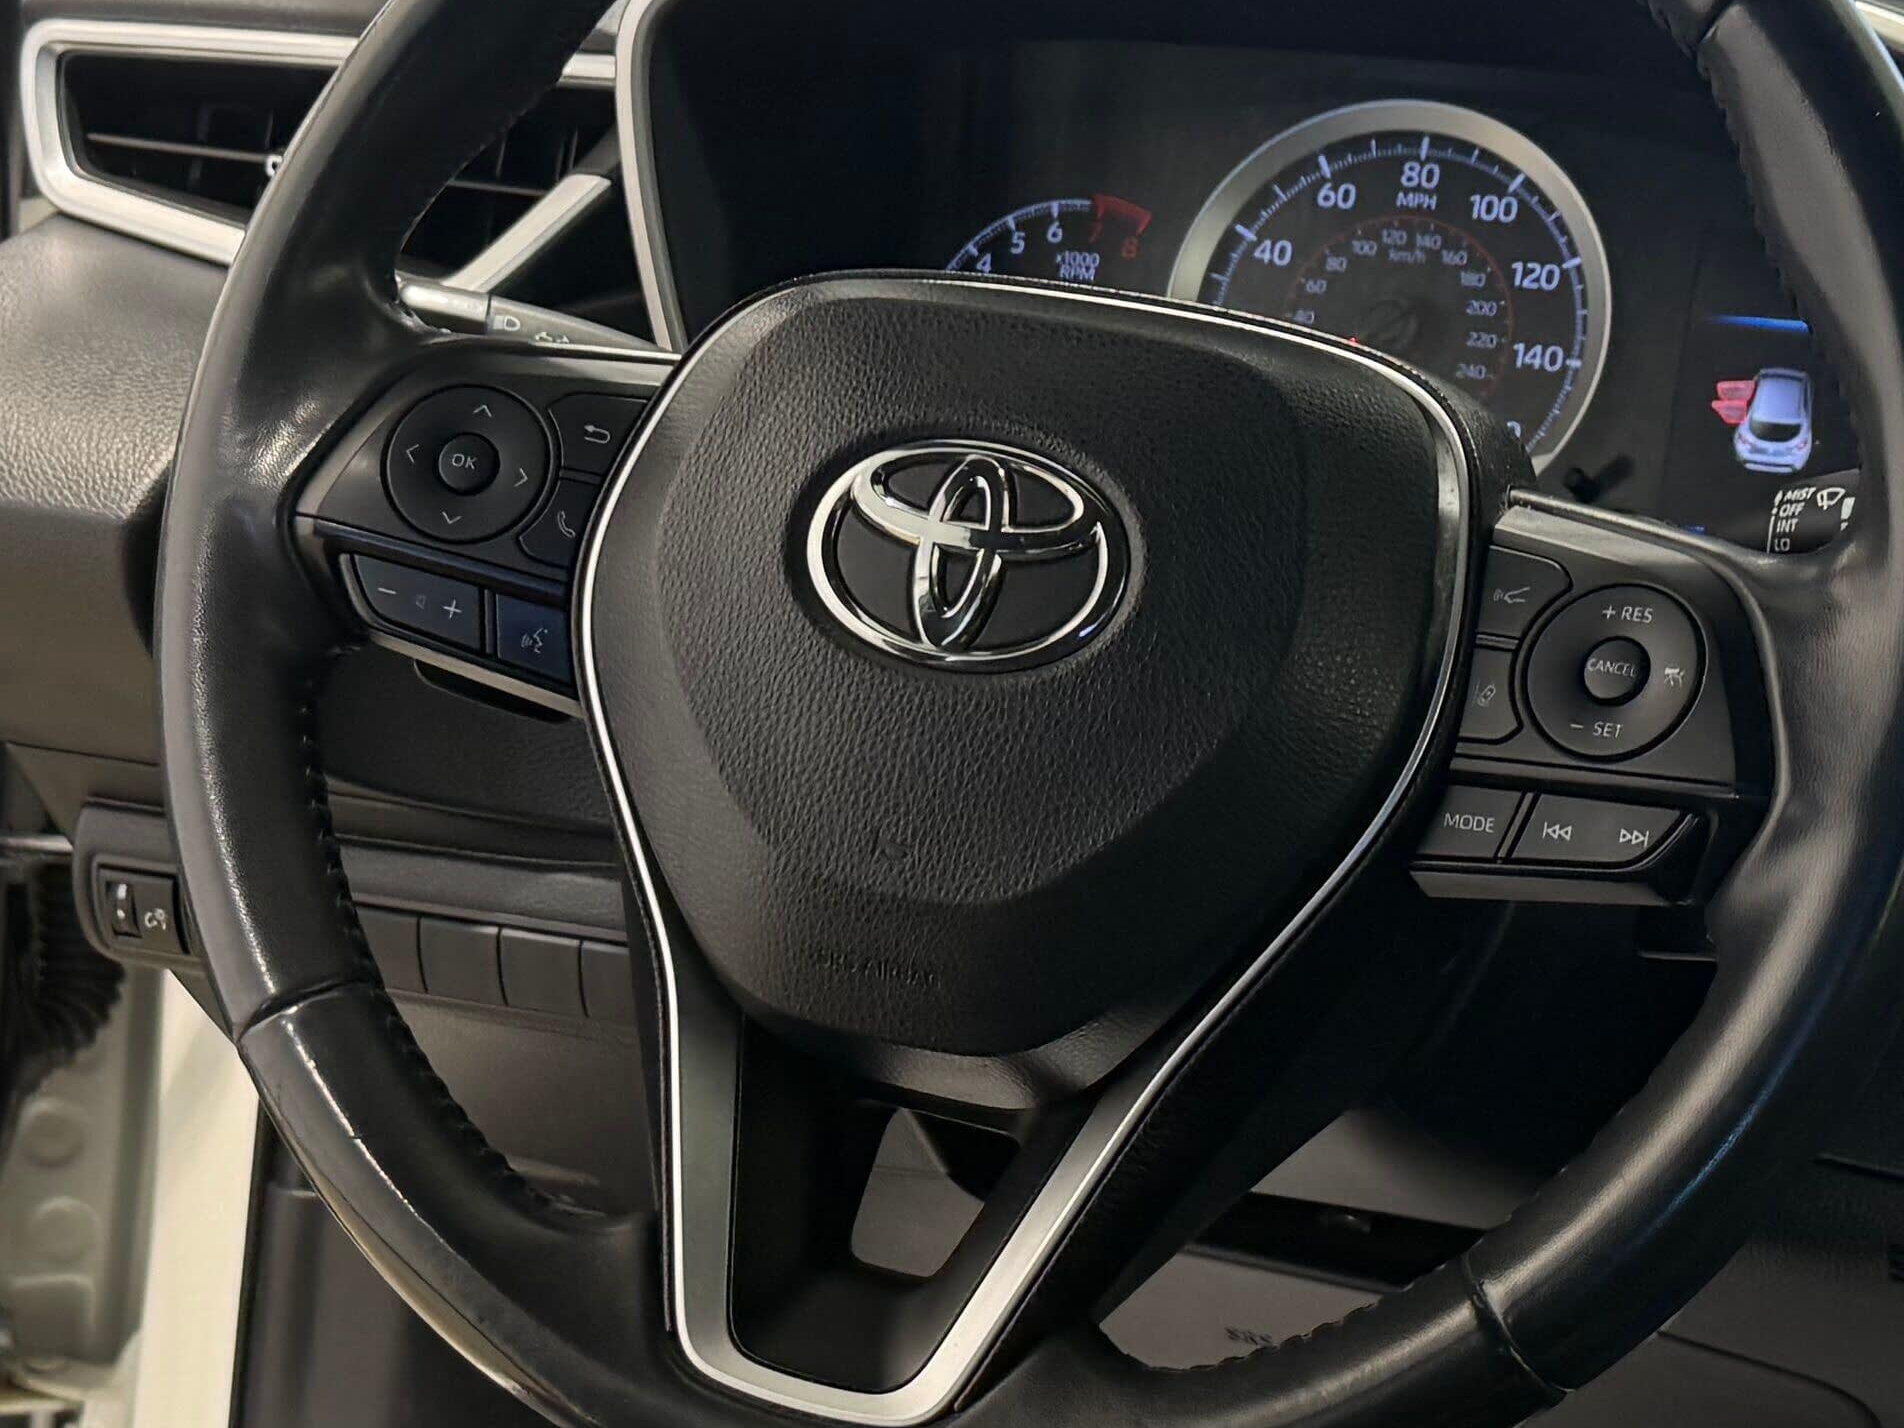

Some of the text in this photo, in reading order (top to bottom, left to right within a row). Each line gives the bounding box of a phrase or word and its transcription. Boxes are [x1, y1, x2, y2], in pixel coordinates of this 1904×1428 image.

[1398, 159, 1442, 192] 80
[1315, 179, 1358, 212] 60
[1394, 189, 1439, 214] MPH
[1469, 192, 1520, 225] 100
[1009, 230, 1027, 256] 5
[1045, 220, 1065, 245] 6
[1120, 235, 1140, 261] 8
[1252, 236, 1294, 269] 40
[974, 252, 993, 274] 4
[1510, 260, 1563, 294] 120
[1511, 341, 1566, 373] 140
[450, 451, 479, 471] OK
[1782, 486, 1818, 503] MIST
[1778, 501, 1806, 518] OFF
[1775, 517, 1800, 534] INT
[1585, 656, 1638, 679] CANCEL
[1592, 720, 1623, 740] SET
[1442, 811, 1496, 835] MODE
